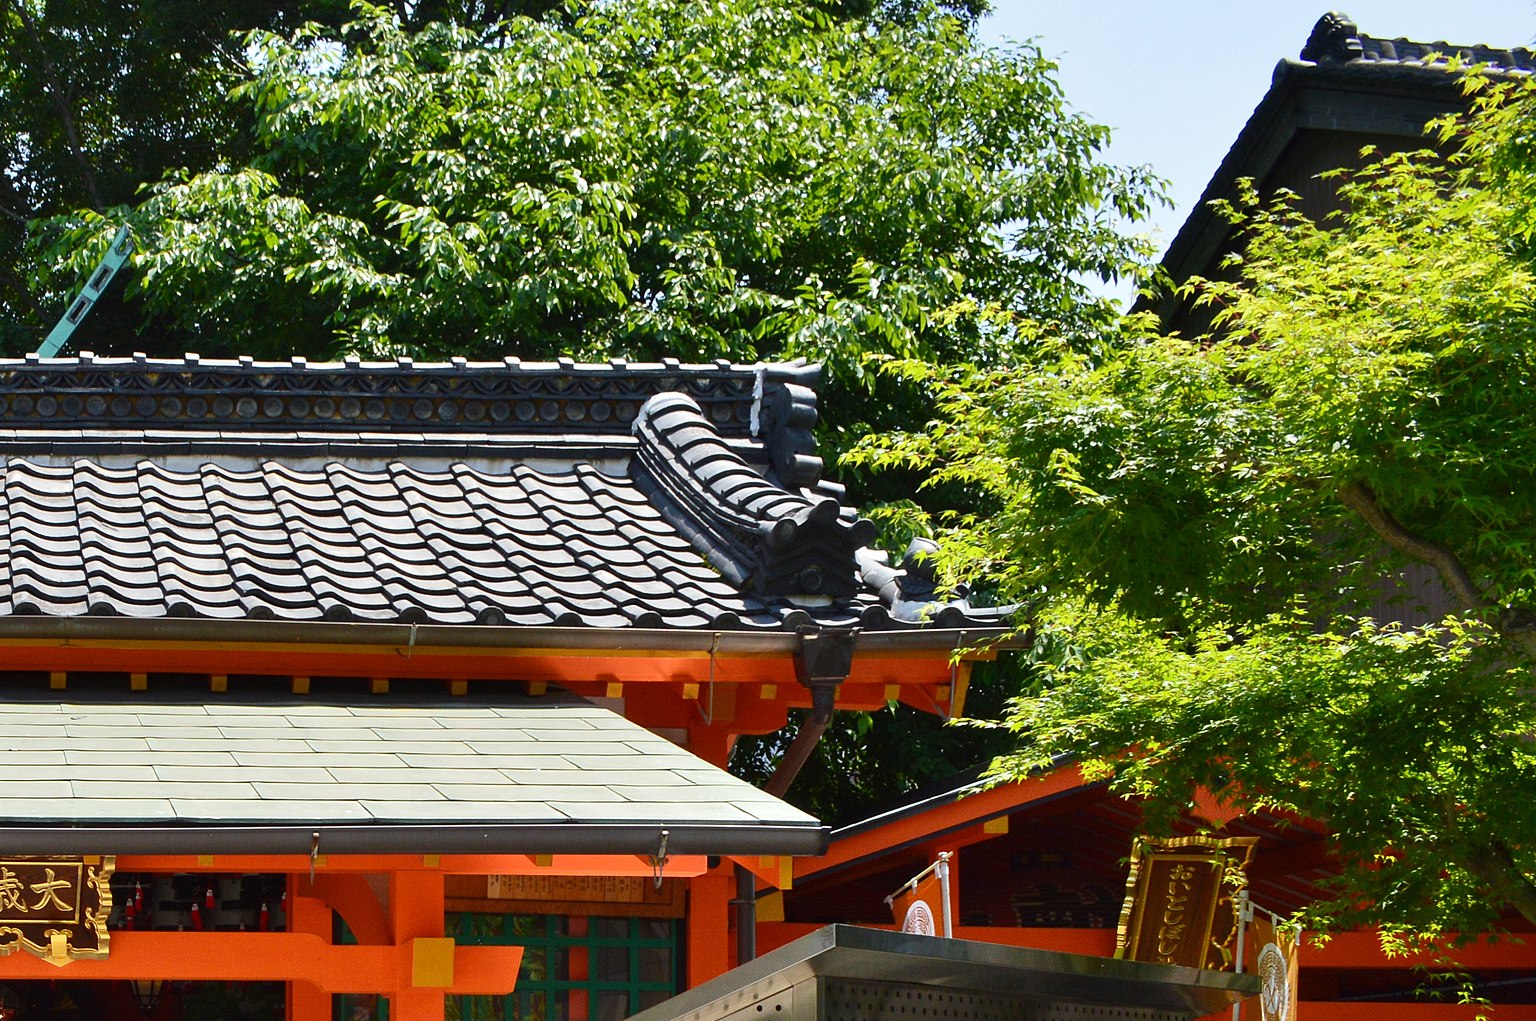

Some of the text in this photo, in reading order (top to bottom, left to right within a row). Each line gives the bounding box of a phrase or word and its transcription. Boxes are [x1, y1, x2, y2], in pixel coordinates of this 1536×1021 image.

[1157, 863, 1196, 963] おいとしぼし
